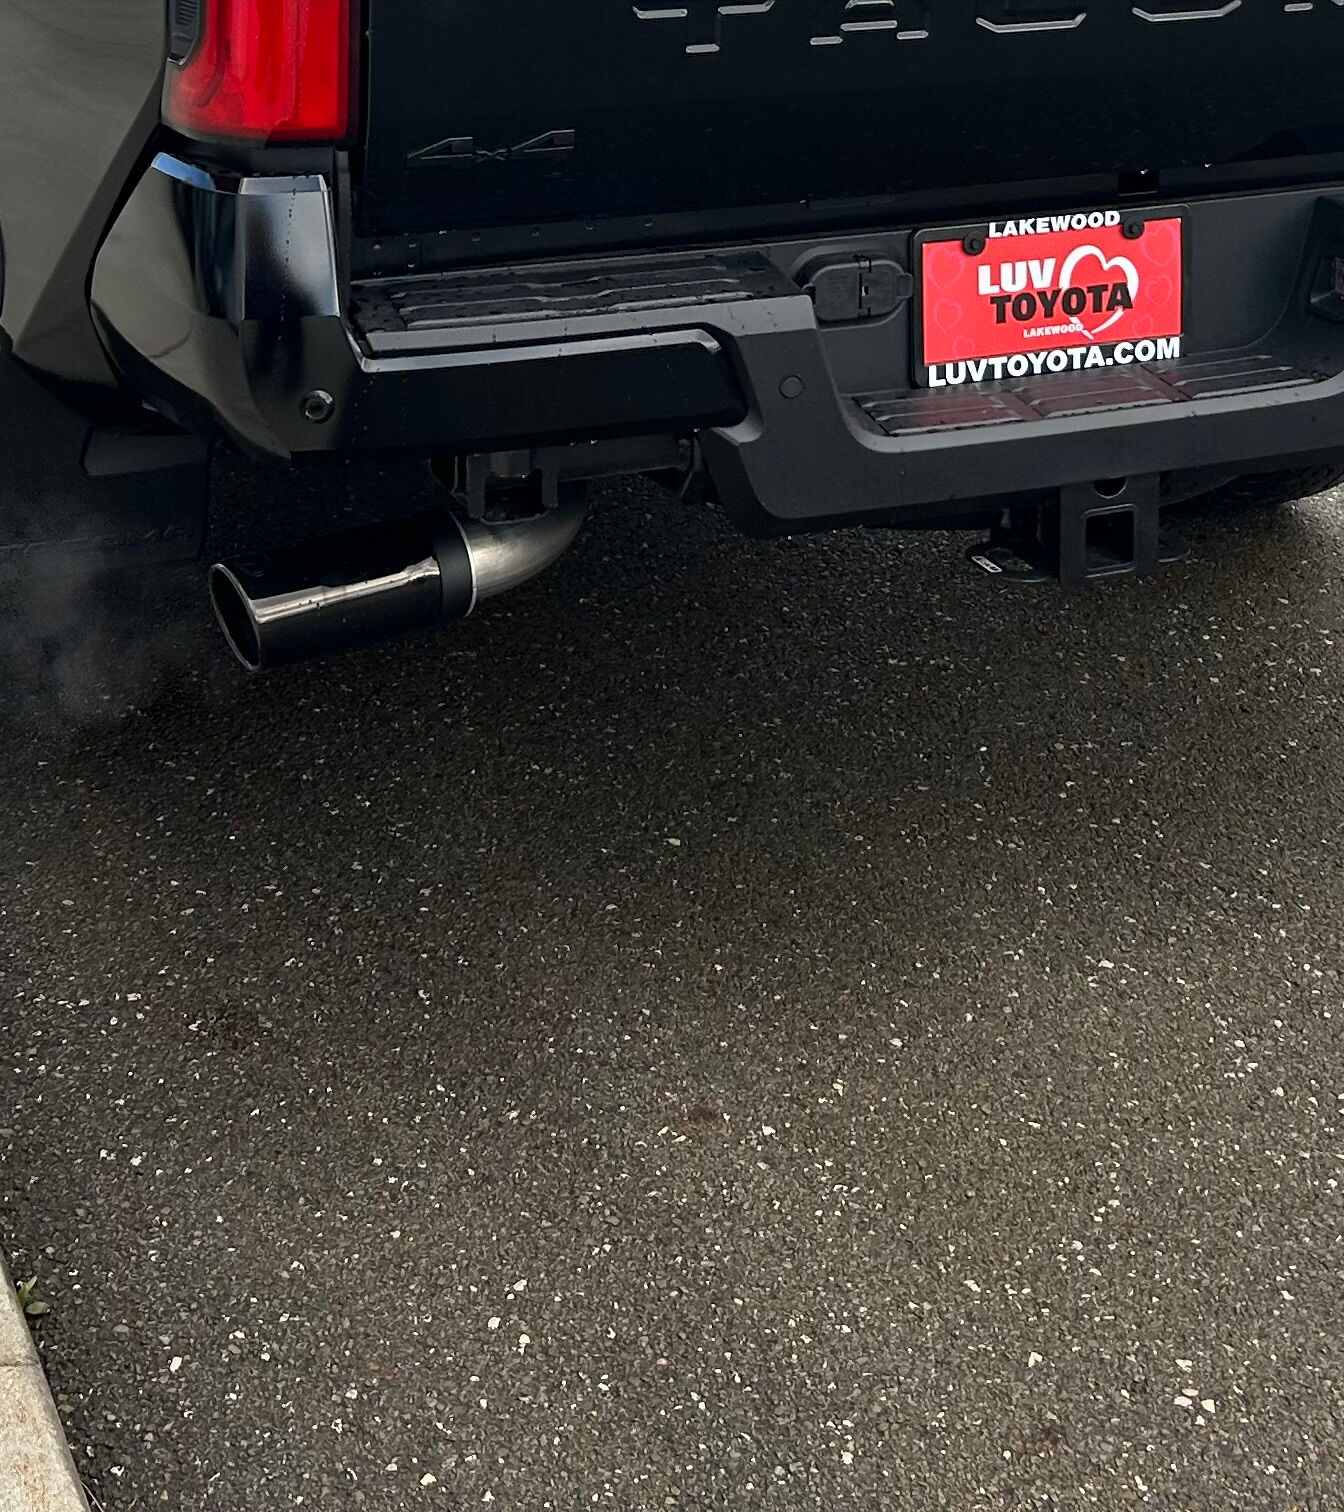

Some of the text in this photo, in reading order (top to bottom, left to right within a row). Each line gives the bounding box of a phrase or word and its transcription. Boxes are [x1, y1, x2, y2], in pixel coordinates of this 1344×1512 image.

[989, 210, 1121, 239] LAKEWOOD
[977, 257, 1056, 295] LUV
[990, 282, 1134, 324] TOYOTA
[1023, 323, 1084, 339] LAKEWOOD
[928, 336, 1181, 388] LUVTOYOTA.COM
